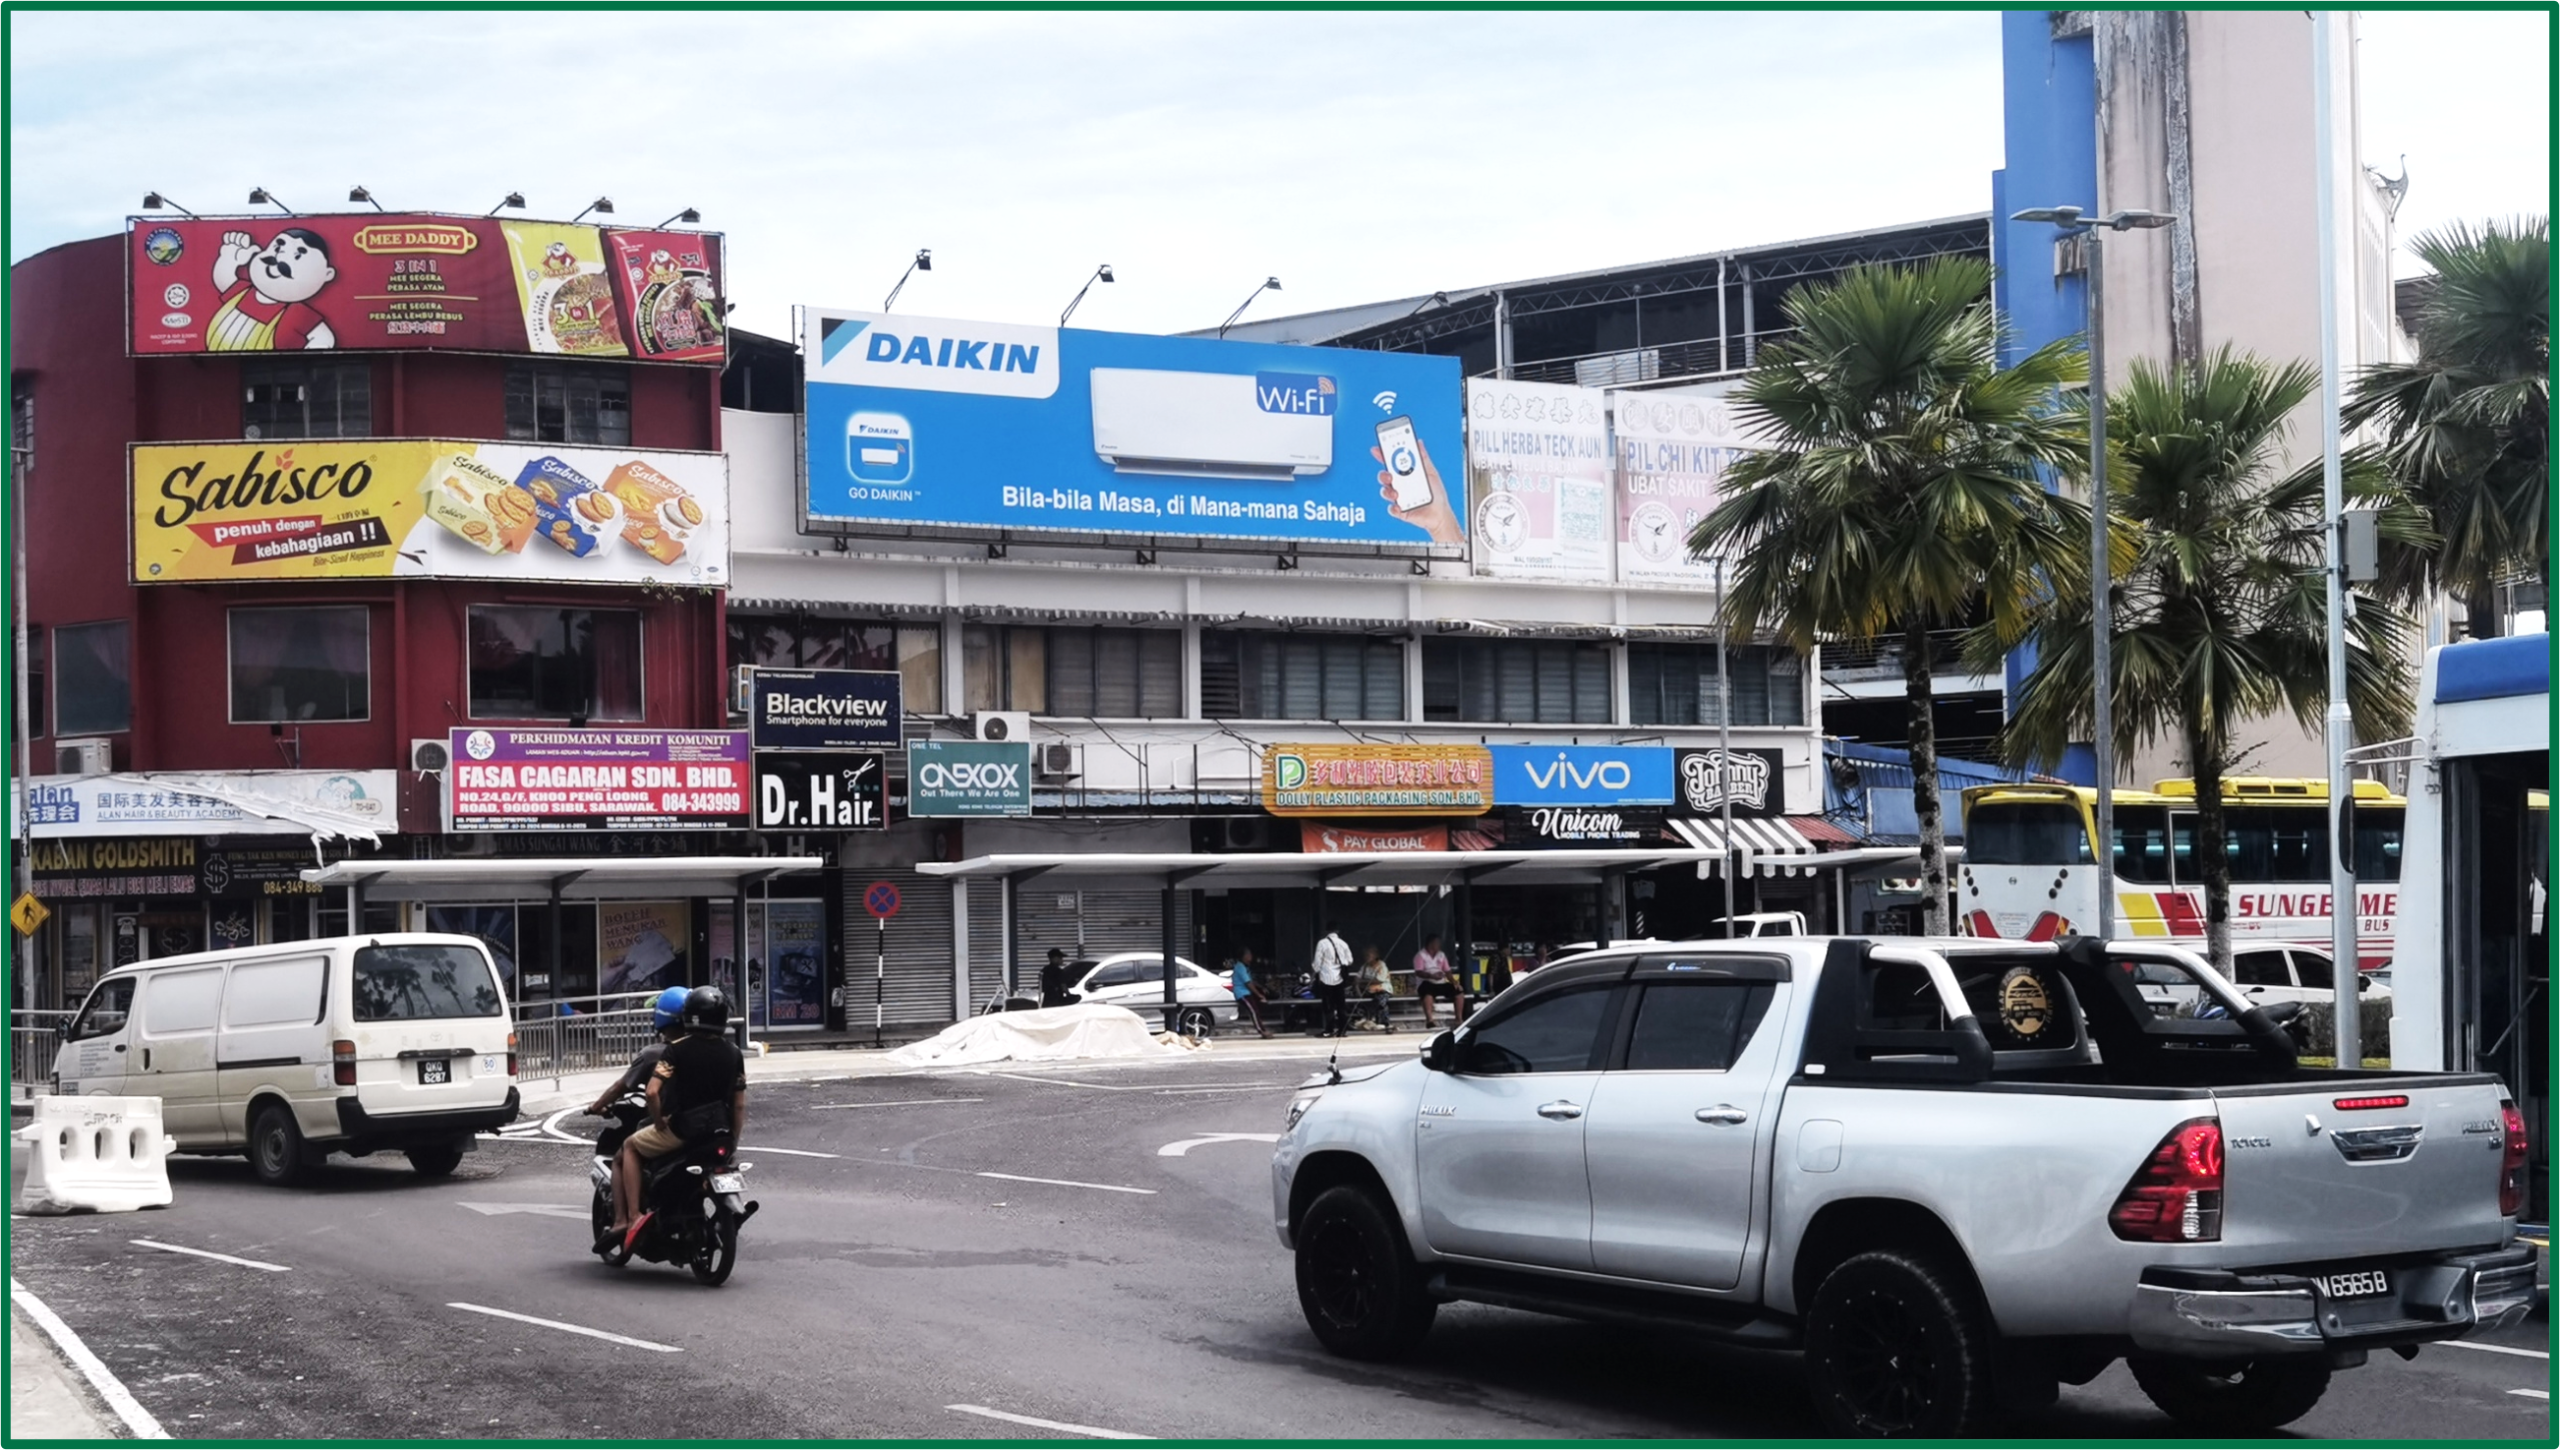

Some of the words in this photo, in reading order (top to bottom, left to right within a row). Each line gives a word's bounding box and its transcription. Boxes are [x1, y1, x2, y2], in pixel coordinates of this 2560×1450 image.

[369, 233, 402, 245] MEE
[405, 233, 461, 246] DADDY
[395, 260, 405, 273] 3
[409, 260, 426, 273] IN
[429, 260, 437, 273] 1
[409, 274, 442, 282] SEGERA
[409, 302, 442, 310] SEGERA
[554, 302, 569, 325] 3
[404, 312, 433, 320] LEMBU
[435, 312, 463, 321] REBUS
[866, 332, 1040, 374] DAIKIN
[1259, 385, 1325, 414] Wi-Fi
[867, 426, 900, 435] DAIKIN
[1473, 429, 1500, 453] PILL
[1502, 431, 1542, 456] HERBA
[1544, 434, 1576, 458] TECK
[1578, 436, 1602, 459] AUN
[1626, 441, 1654, 471] PIL
[1658, 443, 1686, 473] CHI
[1693, 445, 1720, 474] KIT
[452, 455, 508, 487] Sabisco
[541, 459, 595, 490] Sabisco
[628, 463, 683, 495] Sabisco
[154, 451, 372, 528] Sabisco
[848, 487, 868, 500] GO
[871, 488, 913, 501] DAIKIN
[1628, 474, 1665, 496] UBAT
[1668, 477, 1708, 498] SAKIT
[1002, 485, 1093, 512] Bila-bila
[1098, 490, 1163, 519] Masa,
[1166, 494, 1185, 515] di
[1190, 495, 1299, 521] Mana-mana
[1303, 501, 1366, 527] Sahaja
[214, 520, 273, 543] penuh
[275, 519, 316, 533] dengan
[255, 529, 355, 559] kebahagiaan
[350, 549, 385, 564] Happiness
[767, 692, 888, 716] Blackview
[766, 714, 826, 728] Smartphone
[828, 716, 842, 726] for
[844, 717, 888, 729] everyone
[509, 733, 611, 745] PERKHIDMATAN
[615, 734, 663, 746] KREDIT
[667, 734, 731, 746] KOMUNITI
[911, 742, 927, 750] ONE
[928, 742, 943, 750] TEL
[458, 765, 516, 788] FASA
[520, 765, 627, 788] CAGARAN
[631, 766, 683, 788] SDN.
[686, 767, 738, 788] BHD.
[1524, 752, 1631, 790] vivo
[529, 791, 568, 802] KHOO
[569, 791, 604, 802] PENG
[606, 791, 649, 802] LOONG
[762, 774, 873, 825] Dr.Hair
[920, 789, 937, 798] Out
[939, 789, 965, 798] There
[967, 789, 981, 798] We
[984, 789, 999, 798] Are
[1002, 789, 1021, 798] One
[1277, 792, 1311, 806] DOLLY
[1314, 791, 1362, 806] PLASTIC
[1363, 791, 1428, 806] PACKAGING
[1458, 791, 1485, 806] BHD.
[1706, 782, 1754, 801] BABER
[459, 803, 501, 814] ROAD,
[502, 803, 549, 814] 96000
[551, 803, 589, 814] SIBU,
[589, 803, 658, 813] SARAWAK.
[662, 792, 740, 813] 084-343999
[97, 810, 122, 820] ALAN
[124, 810, 146, 819] HAIR
[155, 809, 192, 819] BEAUTY
[195, 809, 242, 819] ACADEMY
[1531, 808, 1622, 840] Unicom
[1343, 835, 1368, 850] PAY
[1371, 836, 1425, 850] GLOBAL
[1560, 831, 1585, 839] MOBILE
[1586, 831, 1610, 839] PHONE
[1611, 830, 1640, 839] TRADING
[528, 835, 567, 852] SUNGAI
[569, 835, 601, 852] WANG
[92, 838, 196, 870] GOLDSMITH
[263, 880, 304, 894] 084-349
[2238, 893, 2332, 917] SUNGE
[604, 907, 651, 925] BOLEH
[2364, 918, 2390, 932] BUS
[772, 1003, 797, 1020] RM
[799, 1003, 821, 1019] 20
[423, 1071, 446, 1083] 6287
[1420, 1103, 1458, 1117] HILUX
